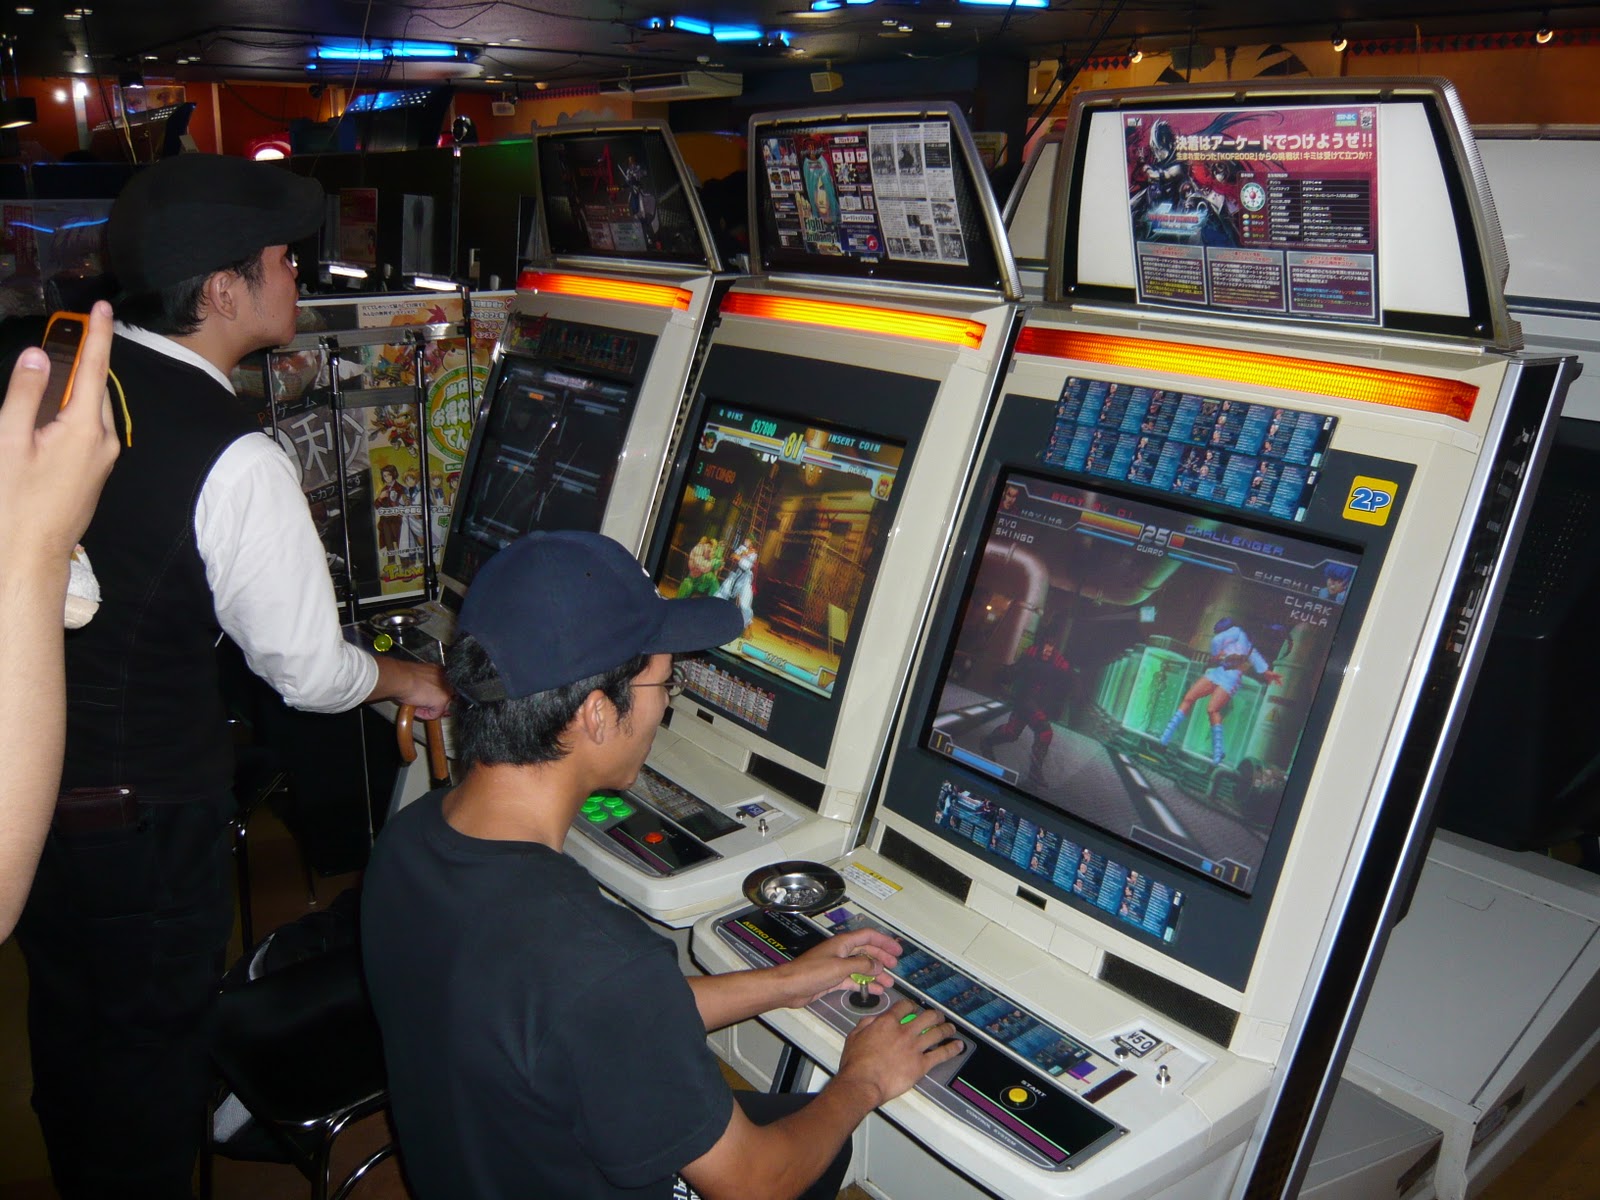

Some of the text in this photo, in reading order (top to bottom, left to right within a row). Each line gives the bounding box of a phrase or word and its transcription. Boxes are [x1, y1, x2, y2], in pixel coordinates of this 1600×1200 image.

[828, 434, 881, 453] INSERT COIN
[1348, 486, 1392, 513] 2P
[997, 517, 1017, 529] RYO
[995, 526, 1035, 544] SHINGO
[1141, 525, 1170, 547] 25
[1184, 524, 1286, 557] CHALLENGER
[1136, 543, 1165, 558] GUARD
[1284, 594, 1333, 617] CLARK
[1289, 609, 1329, 628] KULA
[742, 921, 769, 939] ASTRO
[767, 937, 787, 950] CITY
[1020, 1079, 1047, 1097] START
